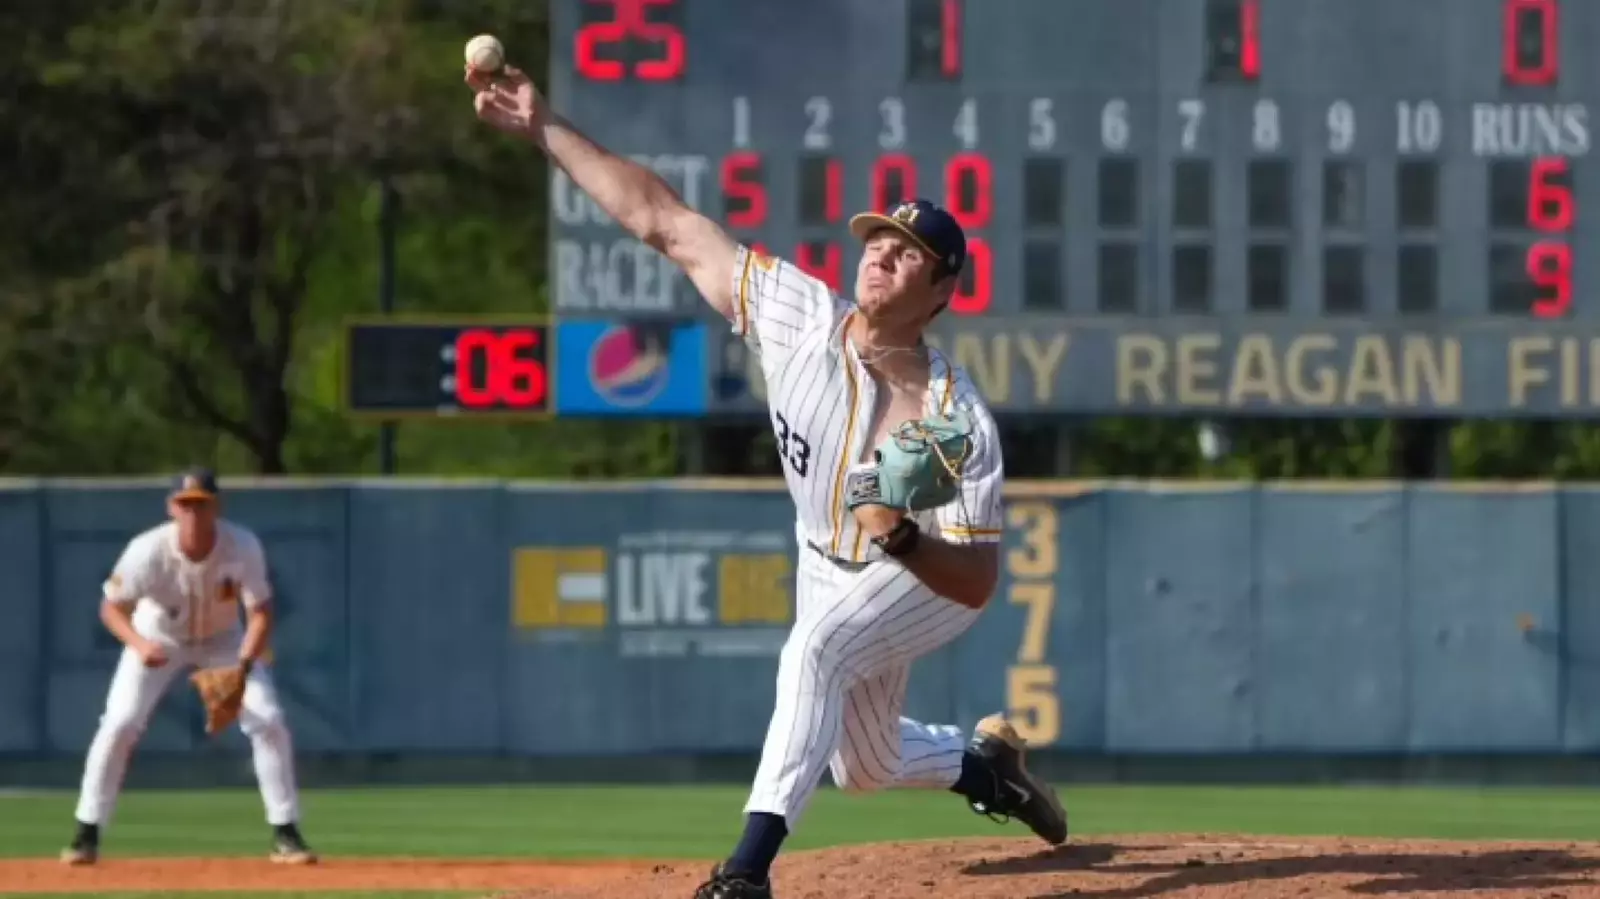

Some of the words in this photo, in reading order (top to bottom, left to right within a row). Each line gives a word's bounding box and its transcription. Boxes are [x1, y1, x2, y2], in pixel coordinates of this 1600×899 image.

[574, 0, 685, 81] 25
[1504, 0, 1558, 84] 0
[732, 97, 750, 148] 1
[804, 97, 832, 149] 2
[879, 98, 906, 149] 3
[952, 99, 980, 149] 4
[1029, 98, 1056, 150] 5
[1101, 99, 1129, 150] 6
[1177, 99, 1204, 151] 7
[1252, 99, 1280, 151] 8
[1327, 100, 1355, 152] 9
[1396, 100, 1442, 152] 10
[1472, 102, 1590, 156] RUNS
[720, 153, 768, 227] 5
[824, 158, 843, 223] 1
[944, 154, 993, 230] 0
[1527, 156, 1575, 232] 6
[1526, 242, 1573, 317] 9
[1116, 334, 1462, 406] REAGAN
[616, 552, 710, 625] LIVE
